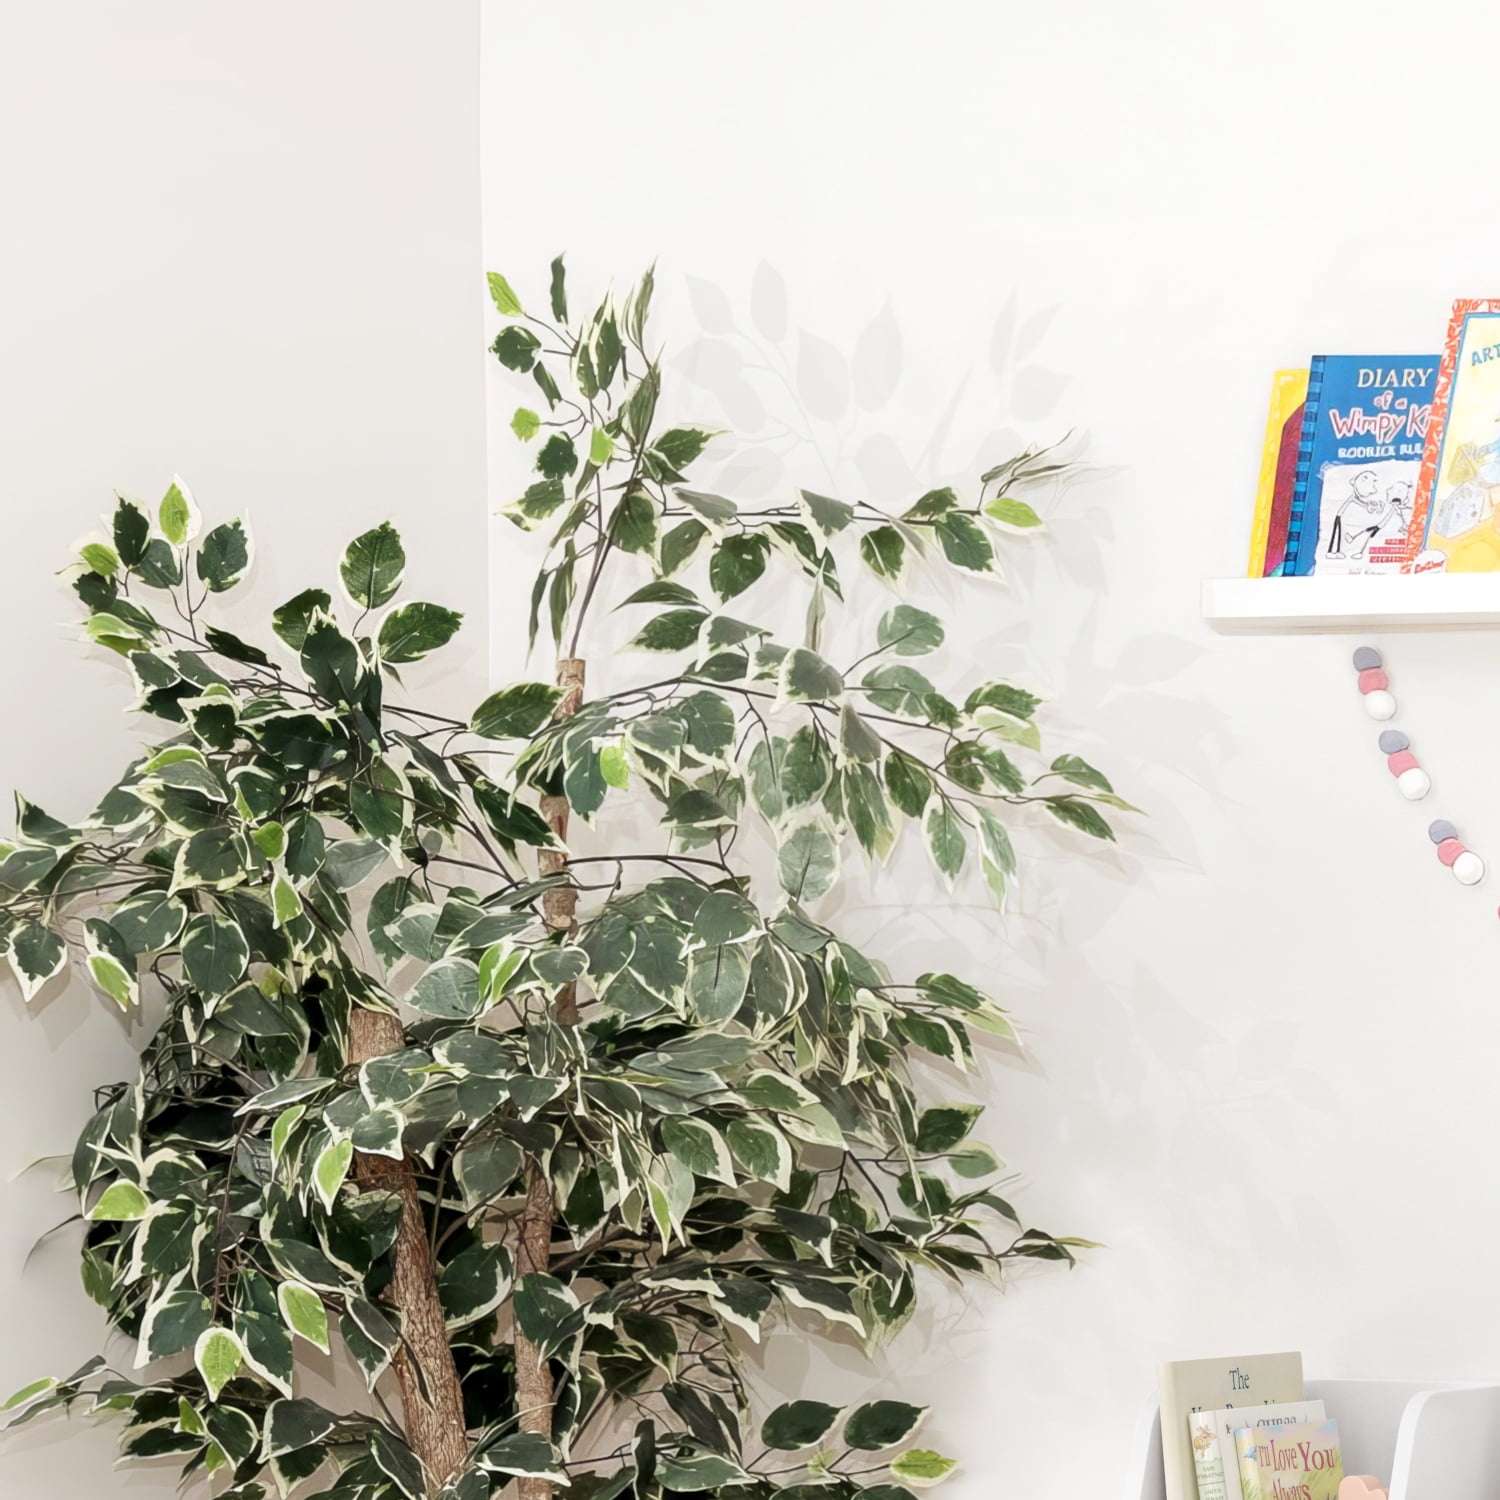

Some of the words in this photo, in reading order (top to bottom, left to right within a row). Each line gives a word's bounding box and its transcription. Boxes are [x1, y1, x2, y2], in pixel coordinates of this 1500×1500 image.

[1356, 368, 1435, 388] DIARY
[1373, 390, 1395, 411] of
[1394, 397, 1408, 410] a
[1328, 407, 1407, 444] Wimpy
[1229, 1368, 1250, 1391] The
[1269, 1440, 1298, 1471] Love
[1297, 1441, 1336, 1471] You
